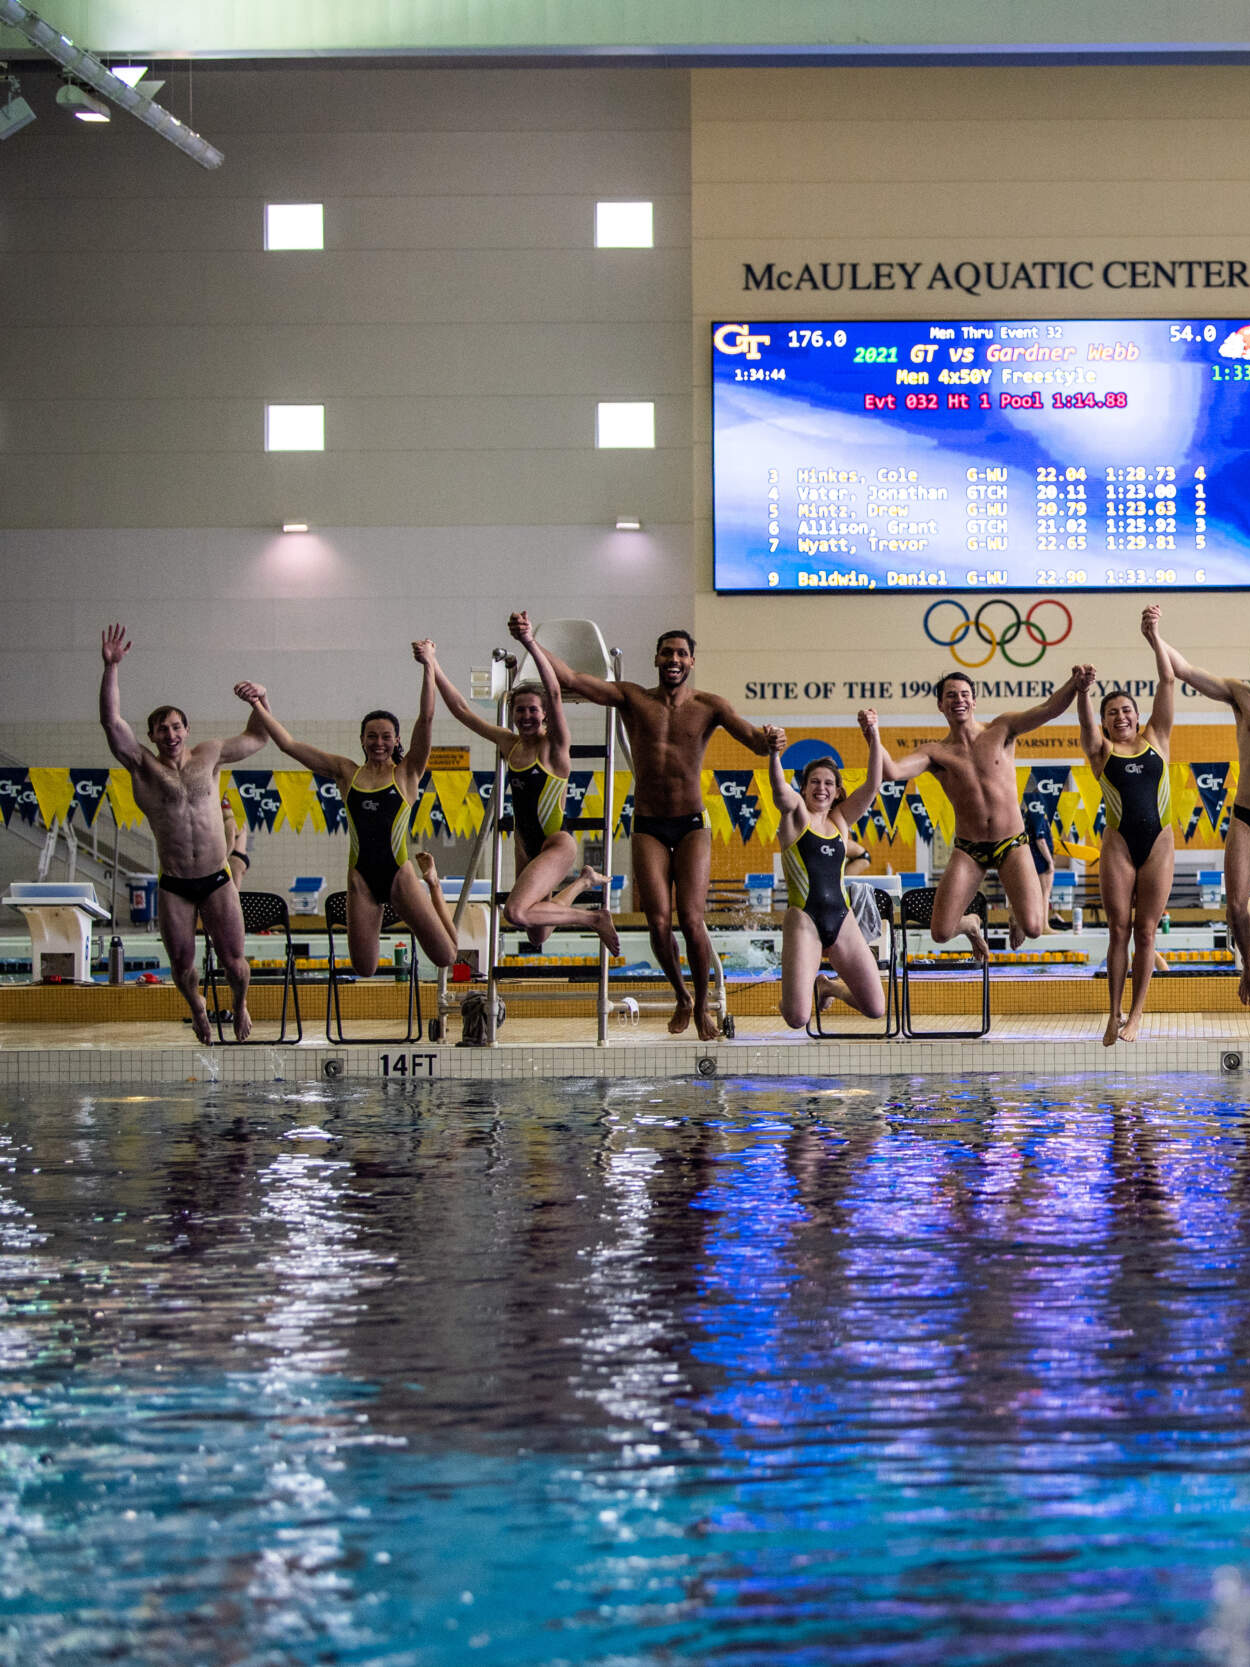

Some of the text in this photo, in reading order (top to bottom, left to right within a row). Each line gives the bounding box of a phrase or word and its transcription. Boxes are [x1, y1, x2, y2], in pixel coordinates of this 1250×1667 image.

[742, 260, 1250, 296] McAULEY AQUATIC CENTER
[713, 324, 770, 360] GT
[788, 330, 847, 348] 176.0
[929, 326, 1063, 340] Men Thru Event 32
[1169, 325, 1217, 342] 54.0
[853, 342, 1140, 363] 2021 GT vs Gardner Webb
[734, 368, 786, 381] 1:34:44
[896, 367, 1097, 387] Men 4x50Y Freestyle
[864, 392, 1127, 410] Evt 032 Ht 1 Pool 1:14.88
[768, 469, 779, 483] 3
[798, 468, 866, 485] Hinkes,
[877, 468, 918, 482] Cole
[966, 468, 1008, 482] G-WU
[1105, 466, 1176, 481] 1:28.73
[1194, 466, 1206, 480] 4
[768, 487, 779, 500] 4
[797, 487, 856, 502] Vater,
[868, 486, 948, 500] Jonathan
[966, 485, 1008, 500] GTCH
[1194, 484, 1206, 498] 1
[768, 504, 779, 518] 5
[867, 503, 908, 517] Drew
[966, 502, 1008, 517] G-WU
[1105, 501, 1176, 516] 1:23.63
[1194, 500, 1206, 515] 2
[768, 521, 779, 535] 6
[798, 520, 876, 536] Allison,
[887, 519, 937, 534] Grant
[966, 519, 1008, 534] GTCH
[1105, 518, 1176, 533] 1:25.92
[1194, 518, 1206, 532] 3
[768, 538, 779, 552] 7
[869, 537, 928, 551] Trevor
[966, 537, 1008, 551] G-WU
[1036, 536, 1087, 551] 22.65
[1105, 535, 1176, 550] 1:29.81
[1194, 535, 1206, 549] 5
[768, 572, 779, 586] 9
[798, 571, 876, 589] Baldwin,
[887, 570, 947, 586] Daniel
[966, 570, 1008, 586] G-WU
[1194, 569, 1206, 584] 6
[745, 681, 798, 700] SITE
[803, 681, 836, 699] OF
[843, 681, 893, 699] THE
[975, 680, 1056, 698] MMER
[1124, 763, 1144, 774] GT
[76, 780, 102, 798] GT
[239, 783, 265, 800] GT
[720, 781, 746, 798] GT
[879, 781, 904, 798] GT
[1037, 779, 1063, 796] GT
[1197, 774, 1223, 791] GT
[260, 798, 280, 811] GT
[821, 845, 835, 856] GT
